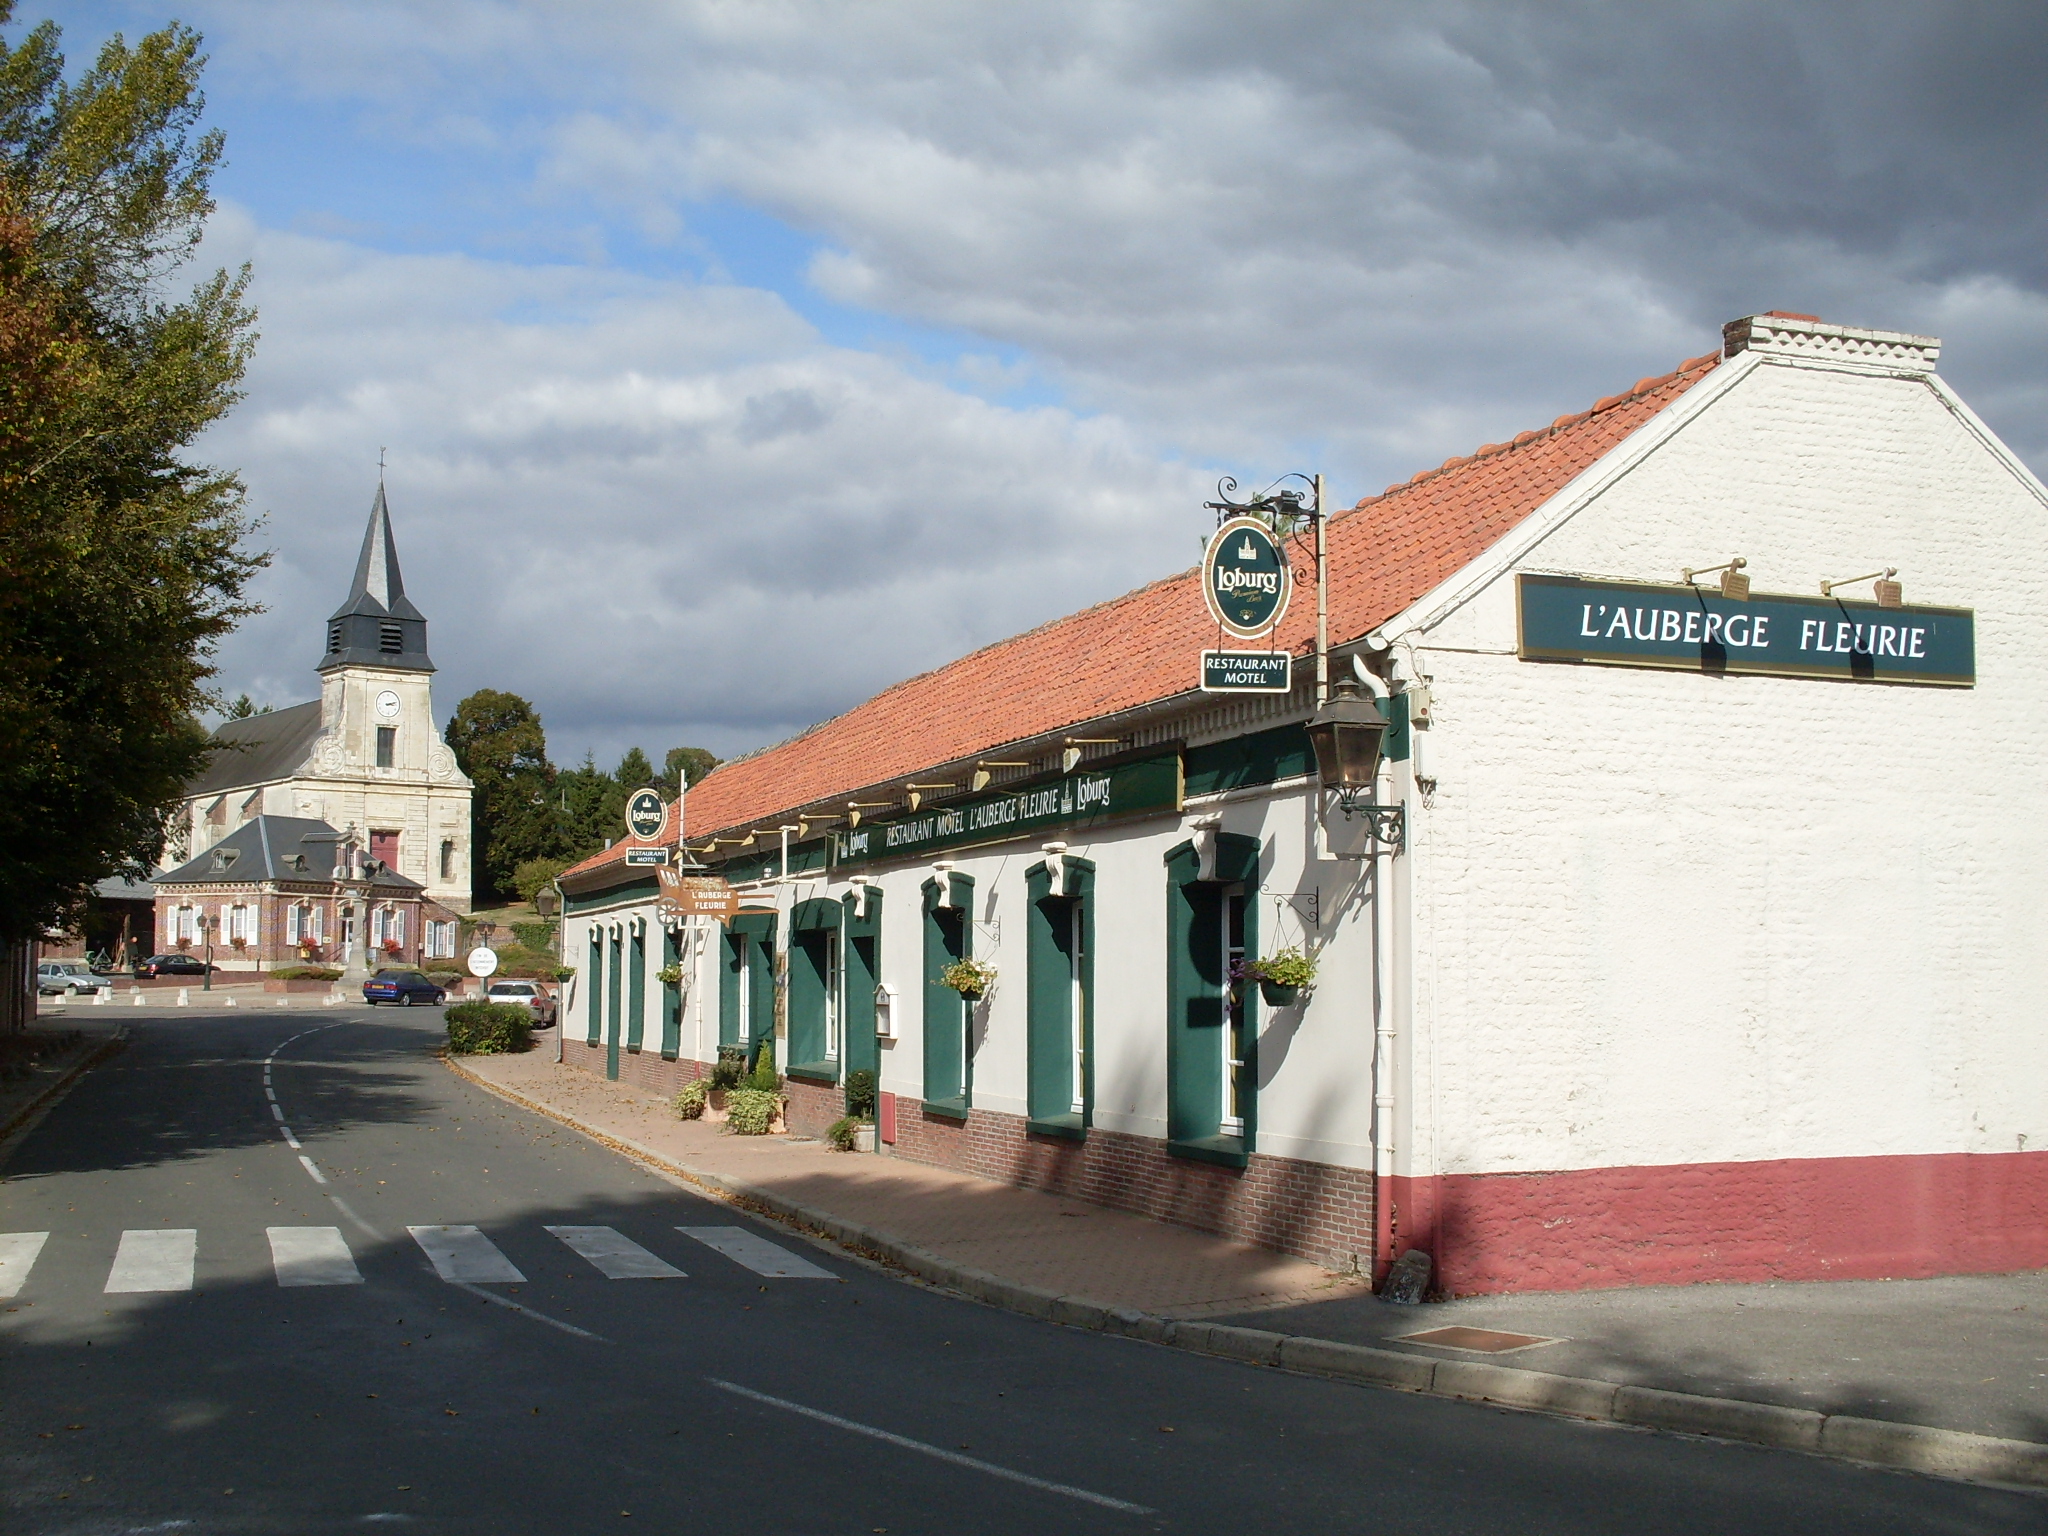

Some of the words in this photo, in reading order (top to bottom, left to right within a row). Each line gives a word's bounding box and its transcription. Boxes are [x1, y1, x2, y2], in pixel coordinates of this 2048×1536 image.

[1217, 565, 1278, 594] Loburg
[1580, 604, 1770, 648] L'AUBERGE
[1799, 619, 1926, 659] FLEURIE
[1206, 658, 1286, 671] RESTAURANT
[1224, 672, 1267, 684] MOTEL
[632, 809, 661, 822] Loburg
[850, 831, 869, 857] Loburg
[886, 817, 935, 847] RESTAURANT
[936, 811, 965, 837] MOTEL
[969, 798, 1017, 831] L'AUBERGE
[1019, 788, 1059, 820] FLEURIE
[1076, 777, 1111, 812] Loburg
[628, 850, 666, 858] RESTAURANT
[691, 891, 732, 899] L'AUBERGE
[694, 901, 727, 910] FLEURIE
